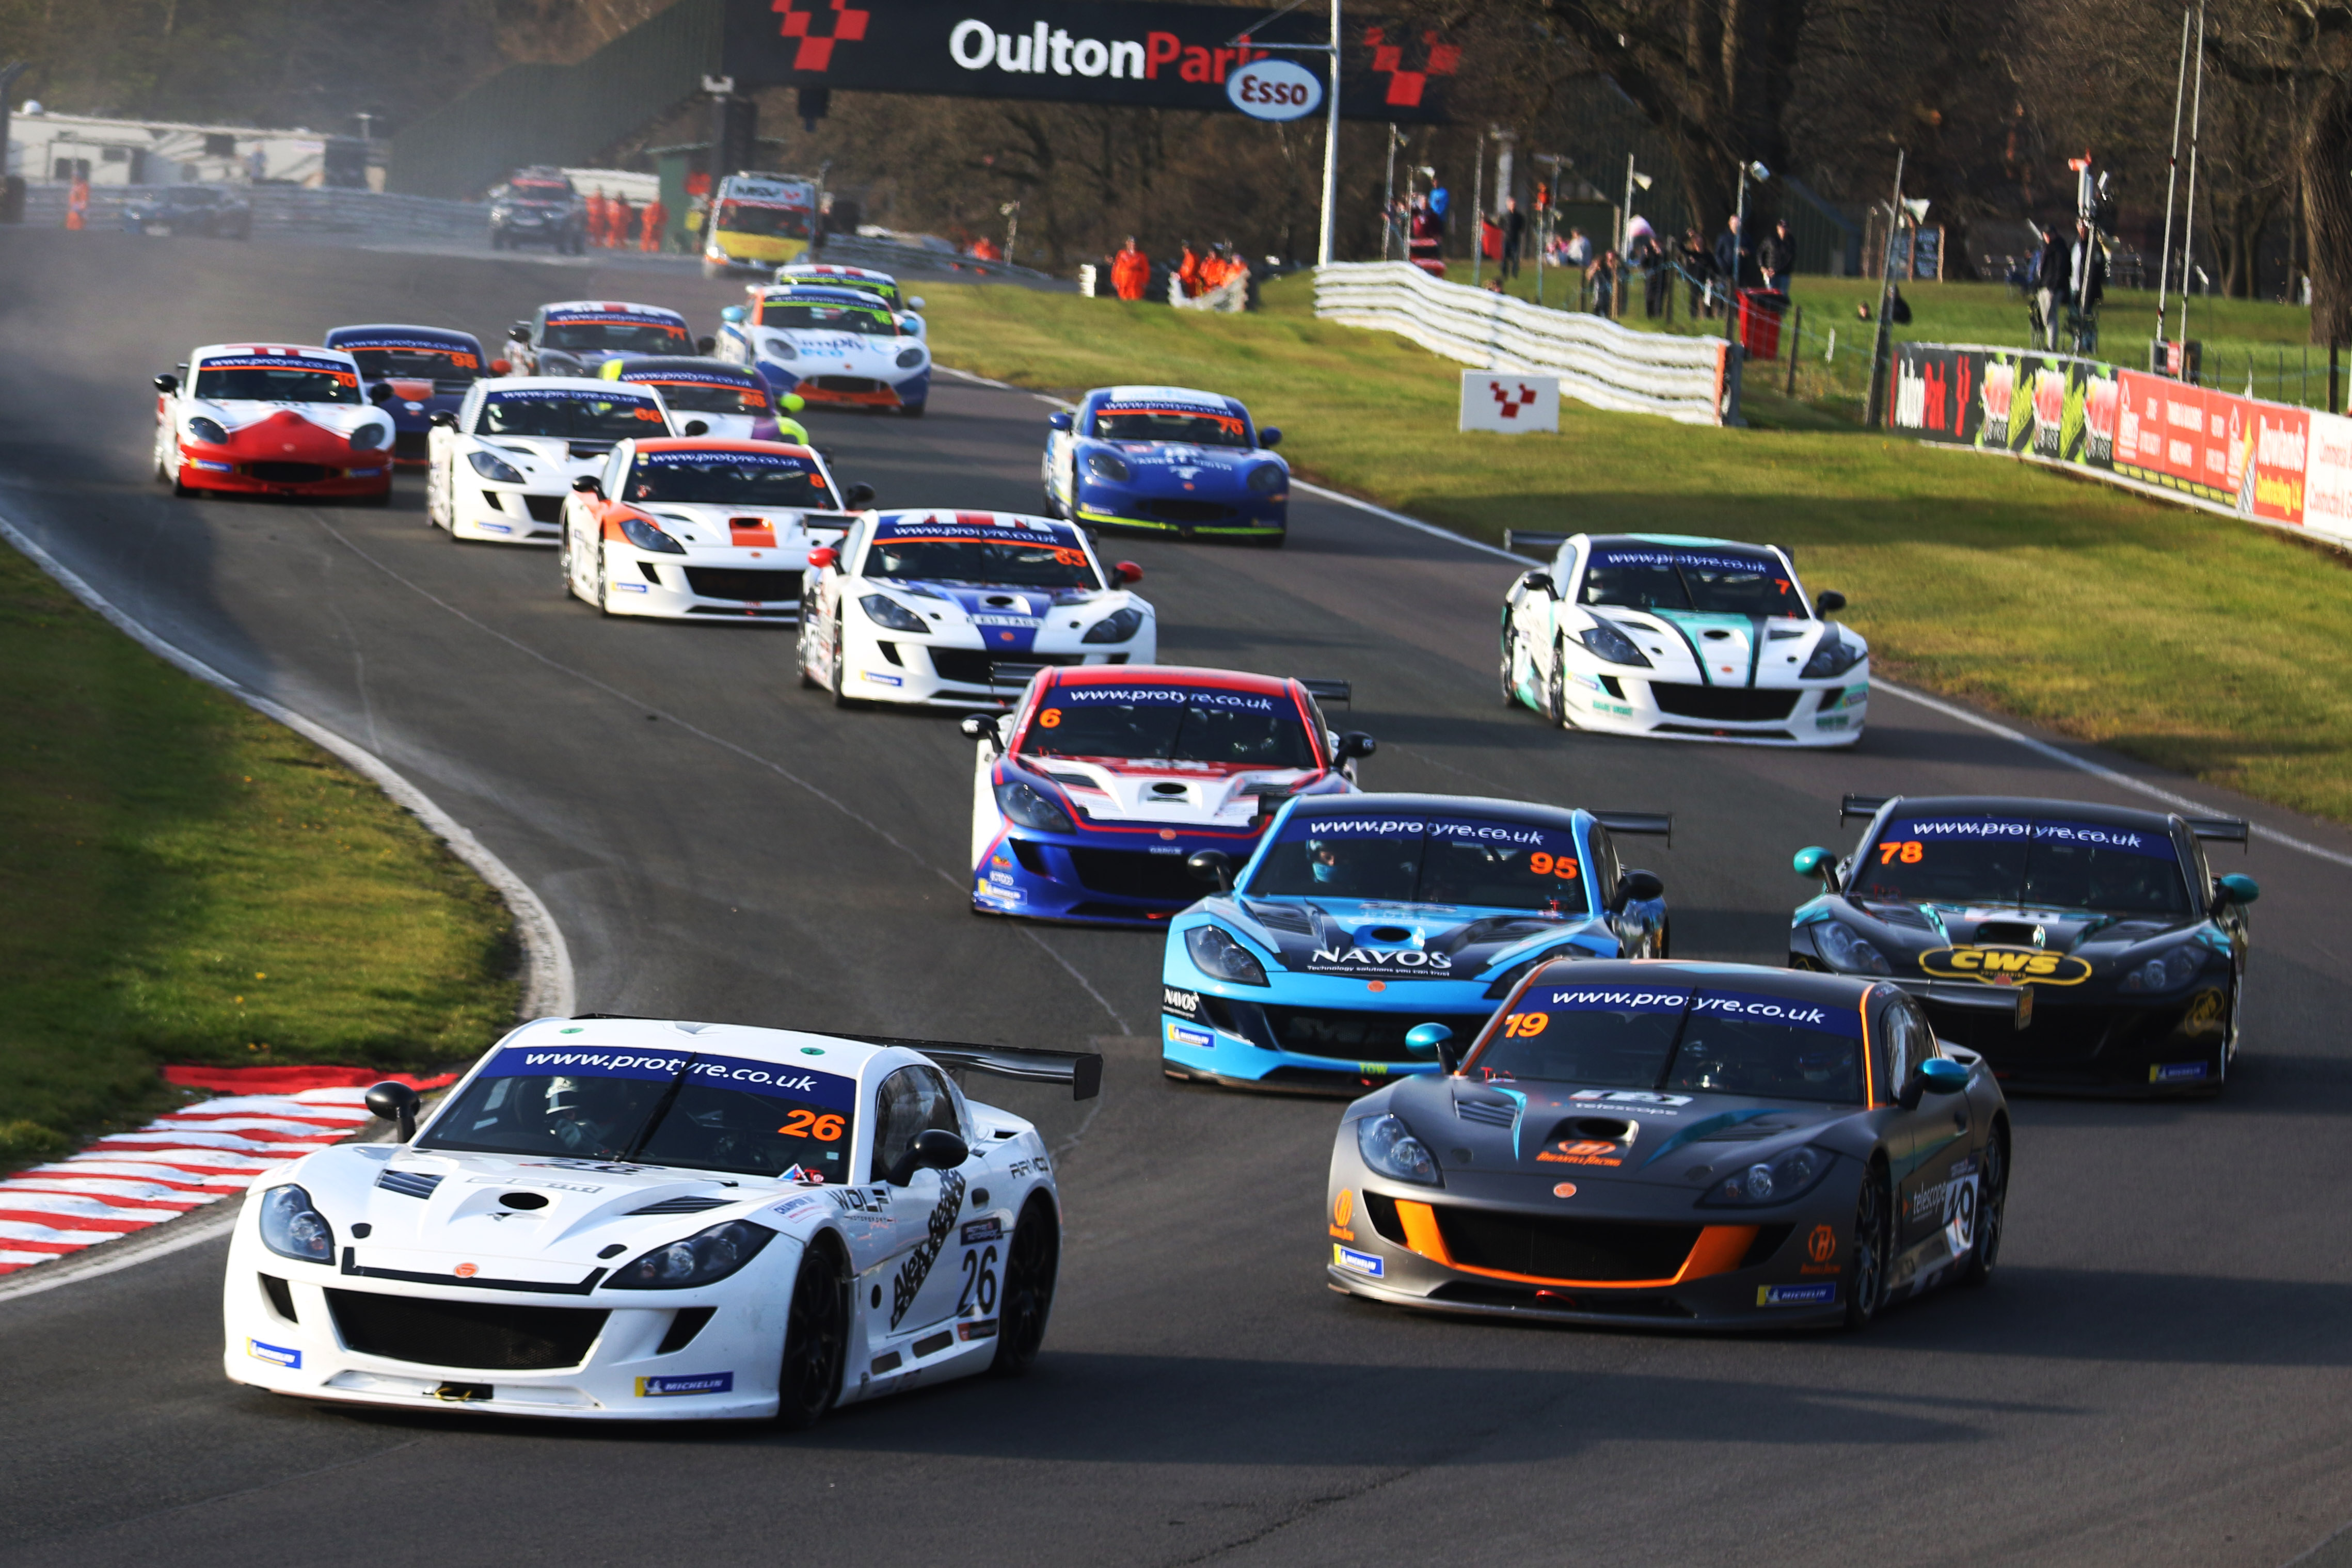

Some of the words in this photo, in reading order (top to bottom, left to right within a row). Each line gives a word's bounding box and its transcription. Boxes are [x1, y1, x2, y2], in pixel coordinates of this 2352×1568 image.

[1240, 74, 1310, 107] Esso
[621, 371, 753, 388] www.protyre.co.uk
[633, 407, 663, 423] 66
[650, 452, 801, 468] www.protyre.co.uk
[1608, 552, 1768, 574] www.protyre.co.uk
[1775, 578, 1791, 595] 7
[1070, 688, 1274, 711] www.protyre.co.uk
[1039, 708, 1062, 728] 6
[1879, 841, 1924, 865] 78
[1529, 852, 1578, 880] 95
[1312, 946, 1452, 969] NAVOS
[1951, 951, 2060, 974] CWS
[1164, 987, 1197, 1012] NAVOS
[1504, 1011, 1548, 1038] 19
[525, 1049, 818, 1093] www.protyre.co.uk
[1359, 1062, 1389, 1075] TOW
[777, 1108, 846, 1142] 26
[1913, 1180, 1946, 1215] telescope
[1948, 1180, 1975, 1243] 19
[1346, 1254, 1377, 1271] MICHELIN
[957, 1244, 998, 1315] 26
[1782, 1289, 1827, 1300] MICHELIN
[665, 1379, 723, 1391] MICHELIN
